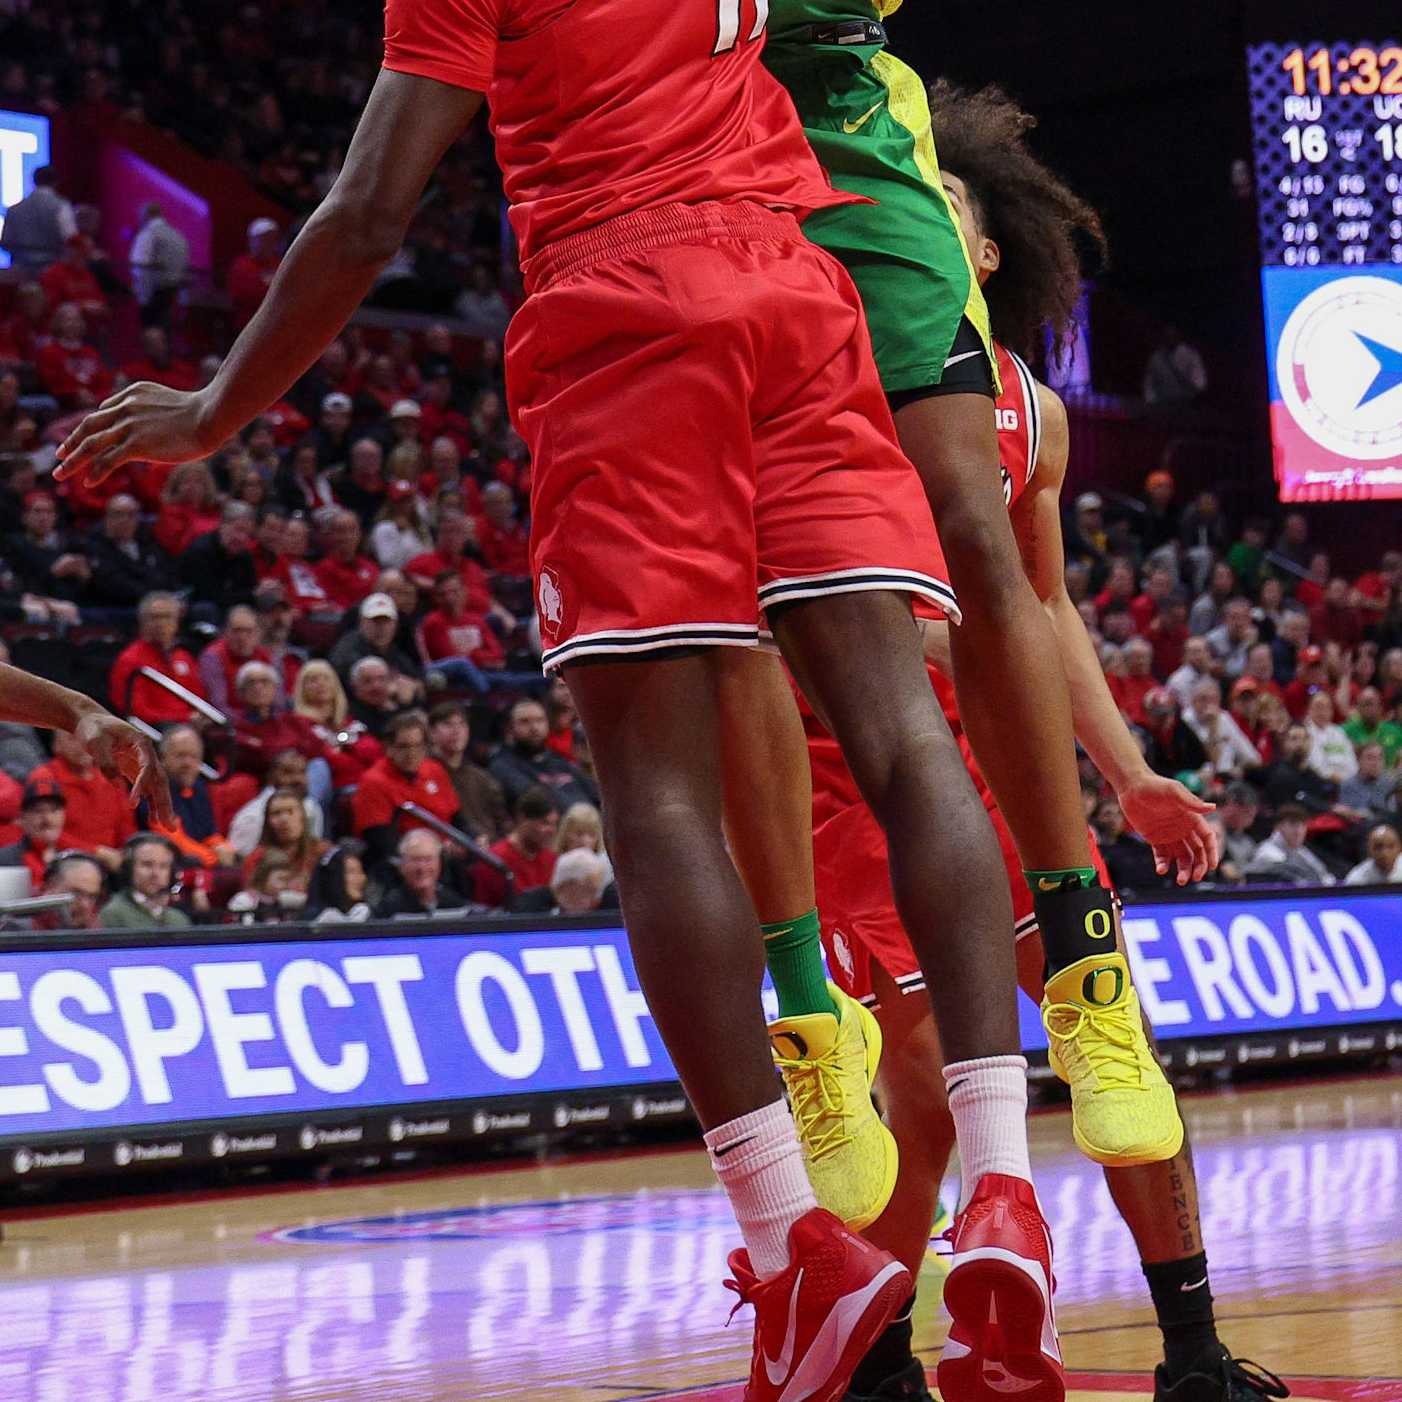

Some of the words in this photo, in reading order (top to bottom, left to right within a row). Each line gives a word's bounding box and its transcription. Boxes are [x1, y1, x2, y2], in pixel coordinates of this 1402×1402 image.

[1283, 95, 1323, 122] RU
[1282, 125, 1329, 163] 16
[1084, 908, 1111, 939] O
[454, 944, 653, 1080] OTH
